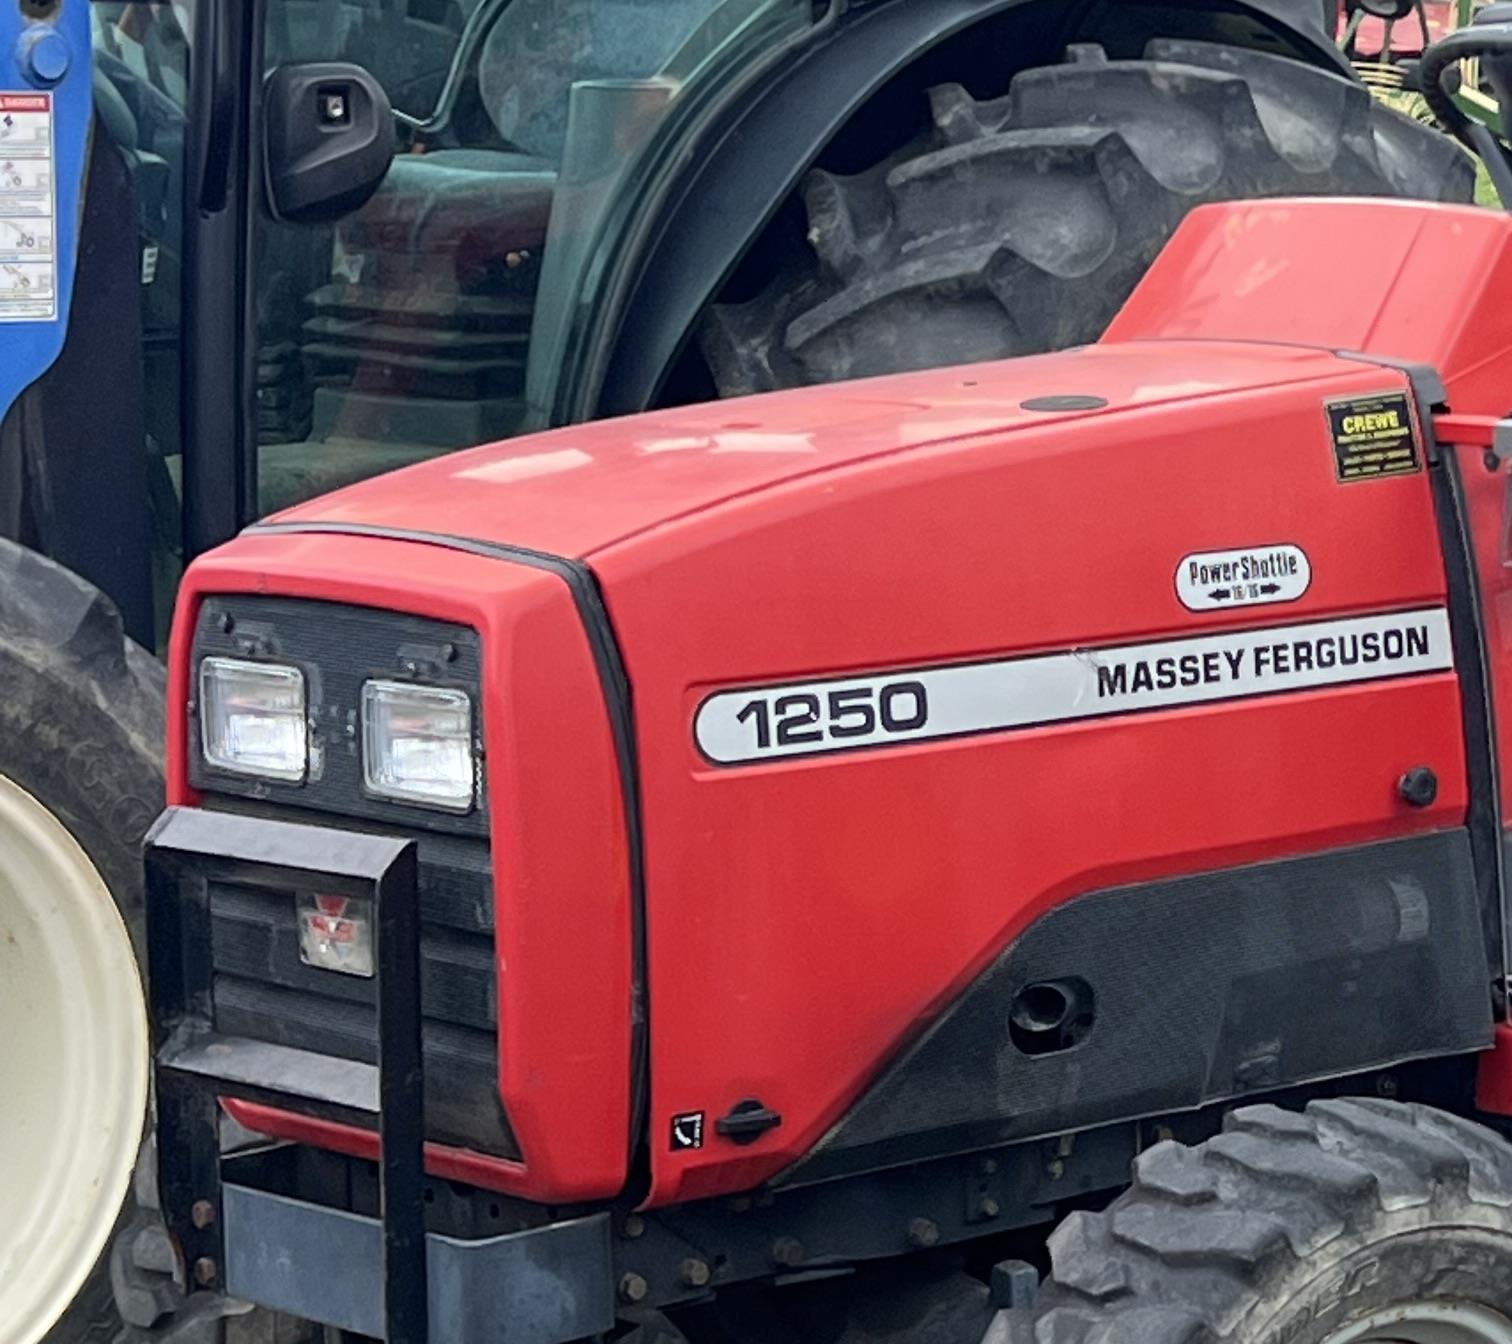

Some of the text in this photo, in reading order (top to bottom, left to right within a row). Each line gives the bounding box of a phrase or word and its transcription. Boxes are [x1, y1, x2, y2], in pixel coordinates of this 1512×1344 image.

[736, 624, 1431, 750] 1250 MASSEY FERGUSON
